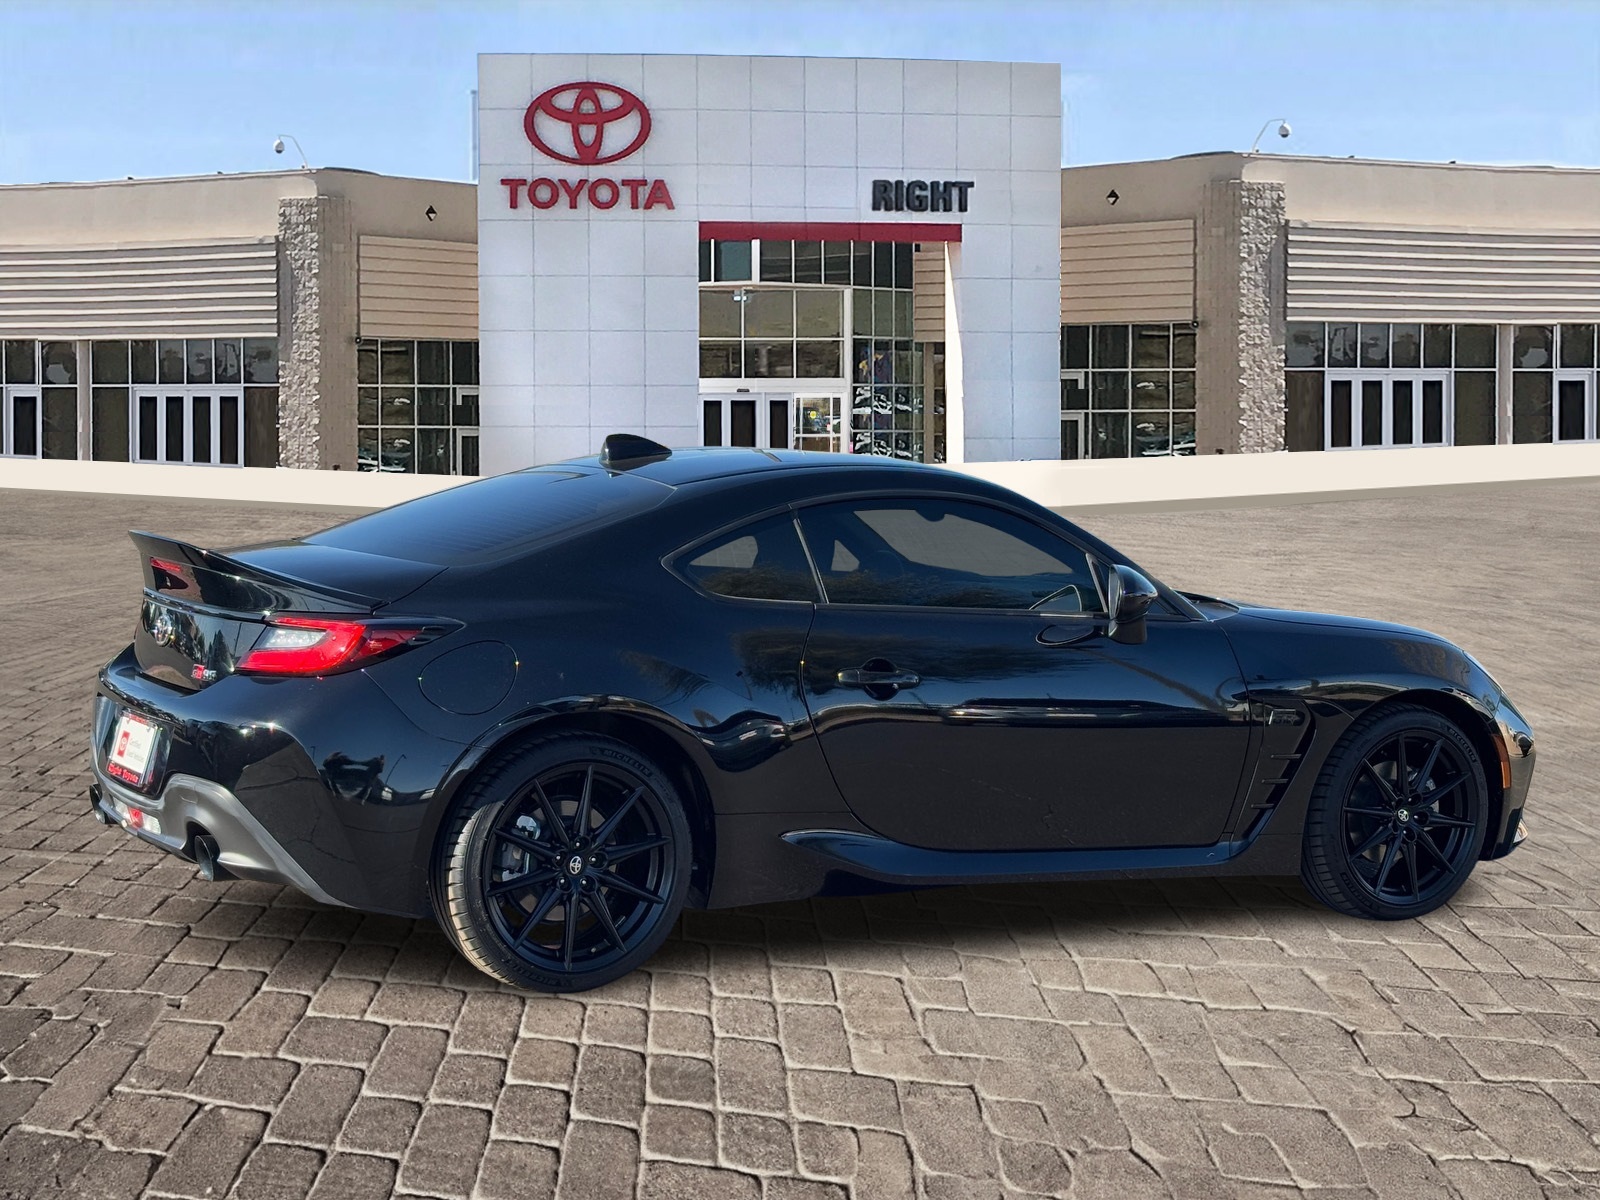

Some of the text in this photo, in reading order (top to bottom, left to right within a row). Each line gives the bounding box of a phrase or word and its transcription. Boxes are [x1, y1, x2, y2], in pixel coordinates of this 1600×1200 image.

[500, 178, 675, 210] TOYOTA
[872, 180, 974, 212] RIGHT
[1448, 727, 1476, 762] MICHELIN
[602, 748, 652, 776] MICHELIN
